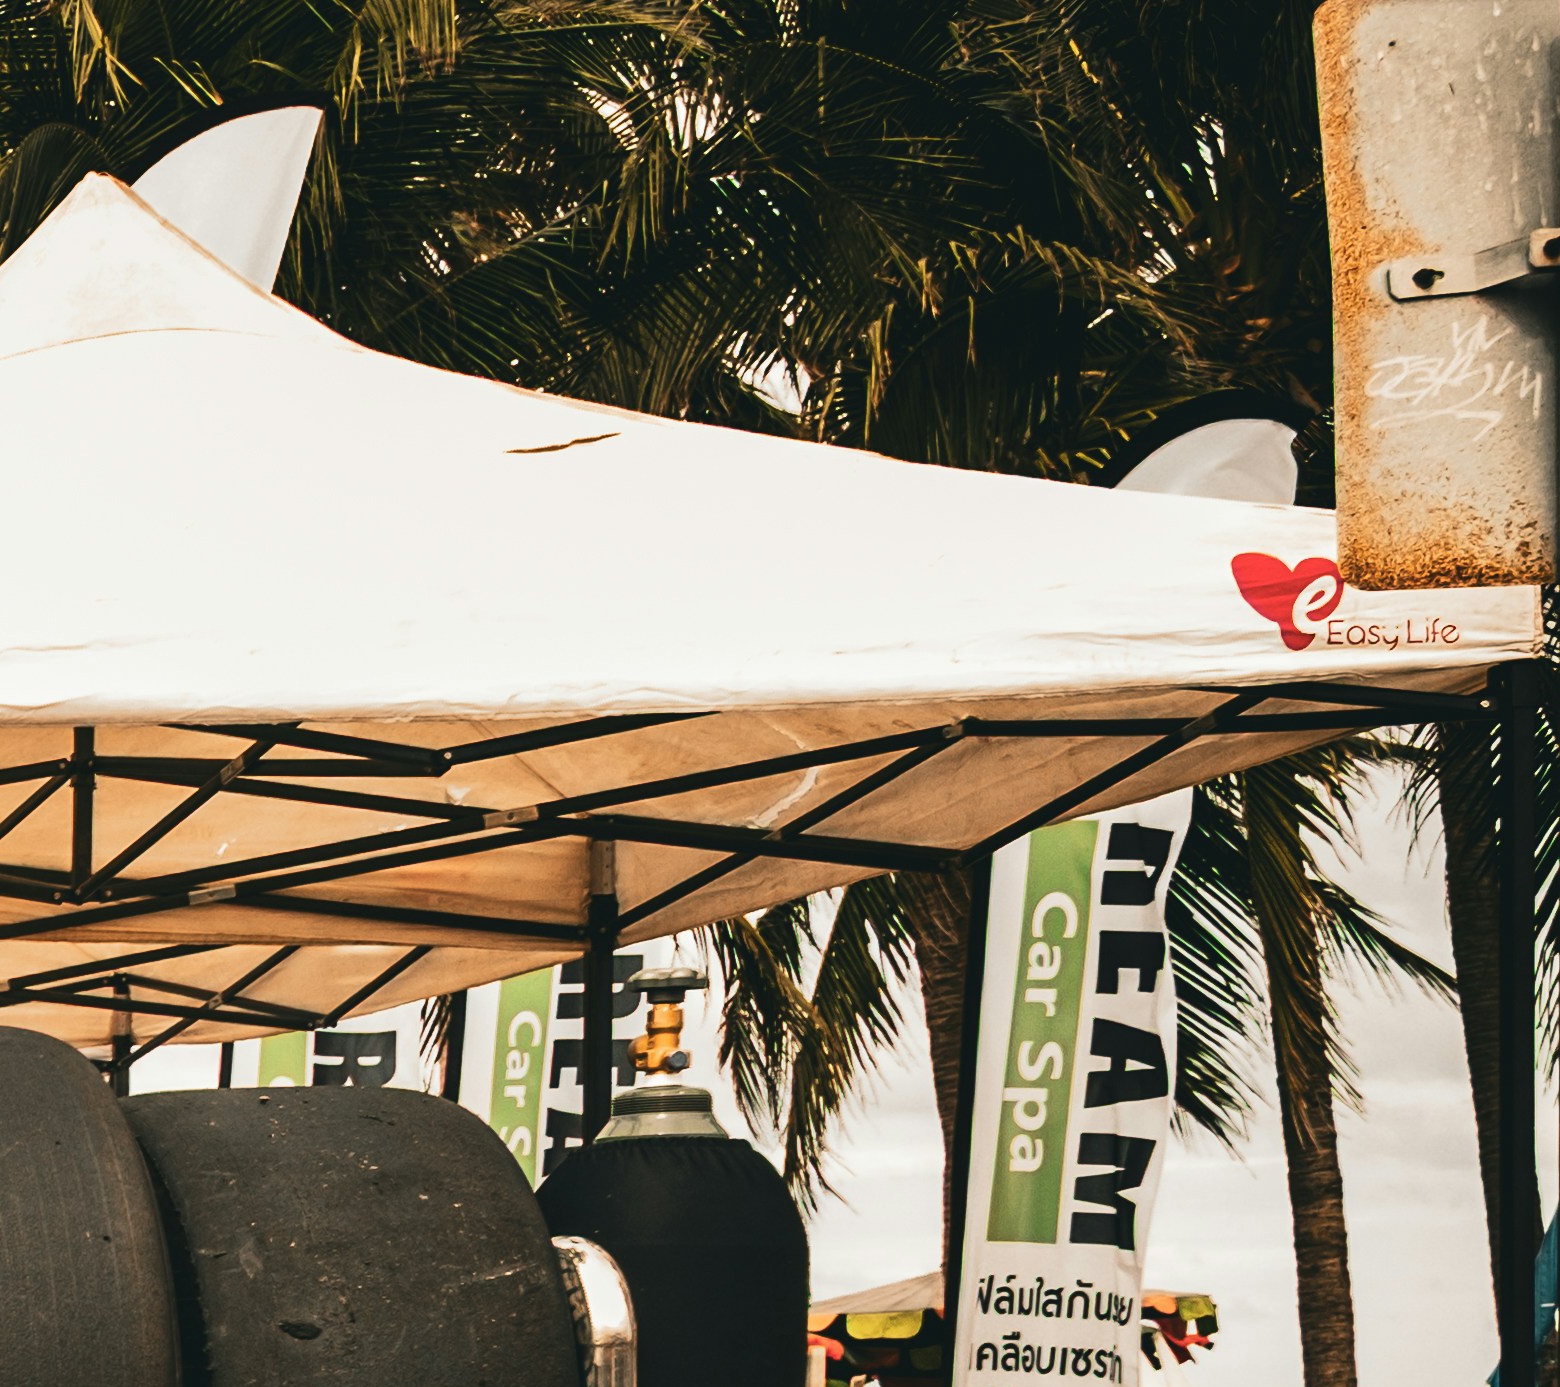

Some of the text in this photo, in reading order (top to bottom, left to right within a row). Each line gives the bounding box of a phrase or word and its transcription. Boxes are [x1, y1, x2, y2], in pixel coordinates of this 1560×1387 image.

[1327, 617, 1460, 650] Easy Life
[504, 1010, 542, 1108] Car
[1002, 891, 1078, 1173] Car Spa
